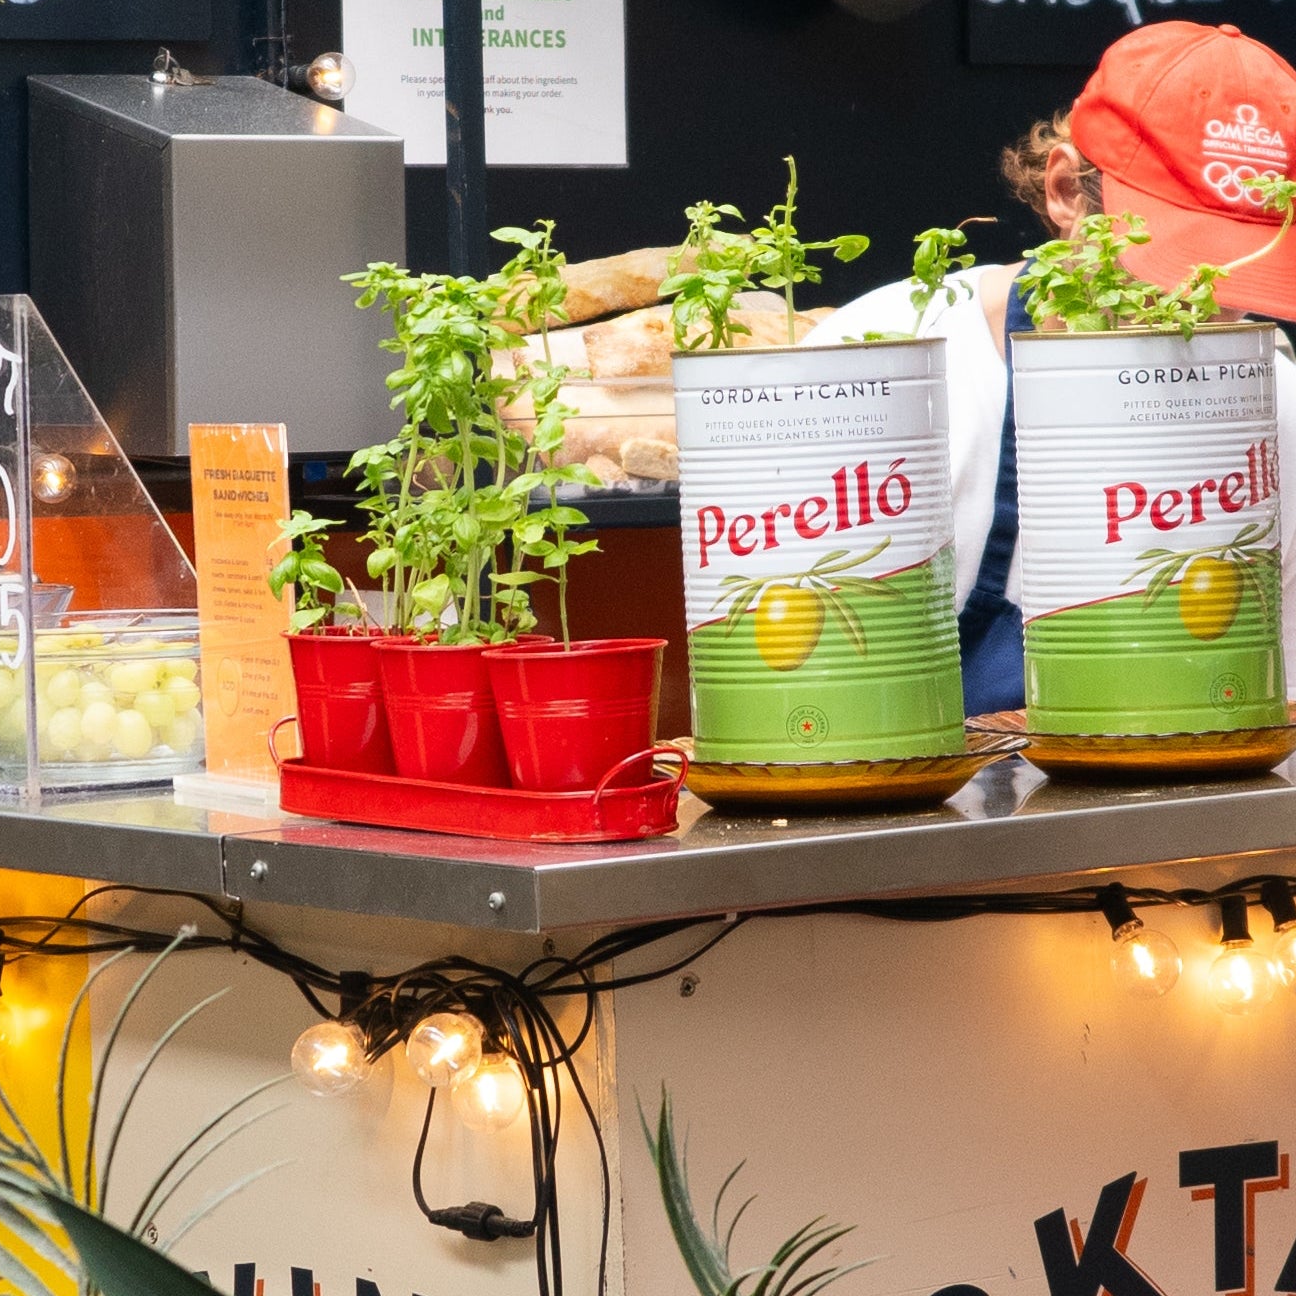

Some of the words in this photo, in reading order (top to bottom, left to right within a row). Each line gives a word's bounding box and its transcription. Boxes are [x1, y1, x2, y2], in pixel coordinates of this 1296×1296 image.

[481, 4, 505, 22] nd
[400, 74, 427, 84] Please
[428, 76, 445, 87] spea
[496, 74, 520, 85] about
[521, 74, 534, 85] the
[535, 75, 578, 87] ingredients
[426, 91, 445, 99] your
[492, 90, 521, 99] making
[521, 91, 540, 100] your
[1205, 119, 1285, 148] OMEGA
[1118, 366, 1211, 385] GORDAL
[701, 385, 783, 405] GORDAL
[794, 380, 891, 401] PICANTE
[1124, 399, 1161, 409] PITTED
[1165, 398, 1202, 408] QUEEN
[1205, 396, 1238, 405] OLIVES
[705, 420, 734, 430] PITTED
[737, 418, 773, 430] QUEEN
[777, 417, 818, 427] OLIVES
[822, 415, 850, 425] WITH
[854, 413, 888, 423] CHILLI
[1130, 412, 1191, 422] ACEITUNAS
[1195, 409, 1239, 419] PICANTES
[709, 433, 762, 443] ACEITUNAS
[766, 430, 821, 441] PICANTES
[825, 429, 843, 438] SIN
[848, 426, 884, 437] HUESO
[696, 457, 912, 568] Perelló
